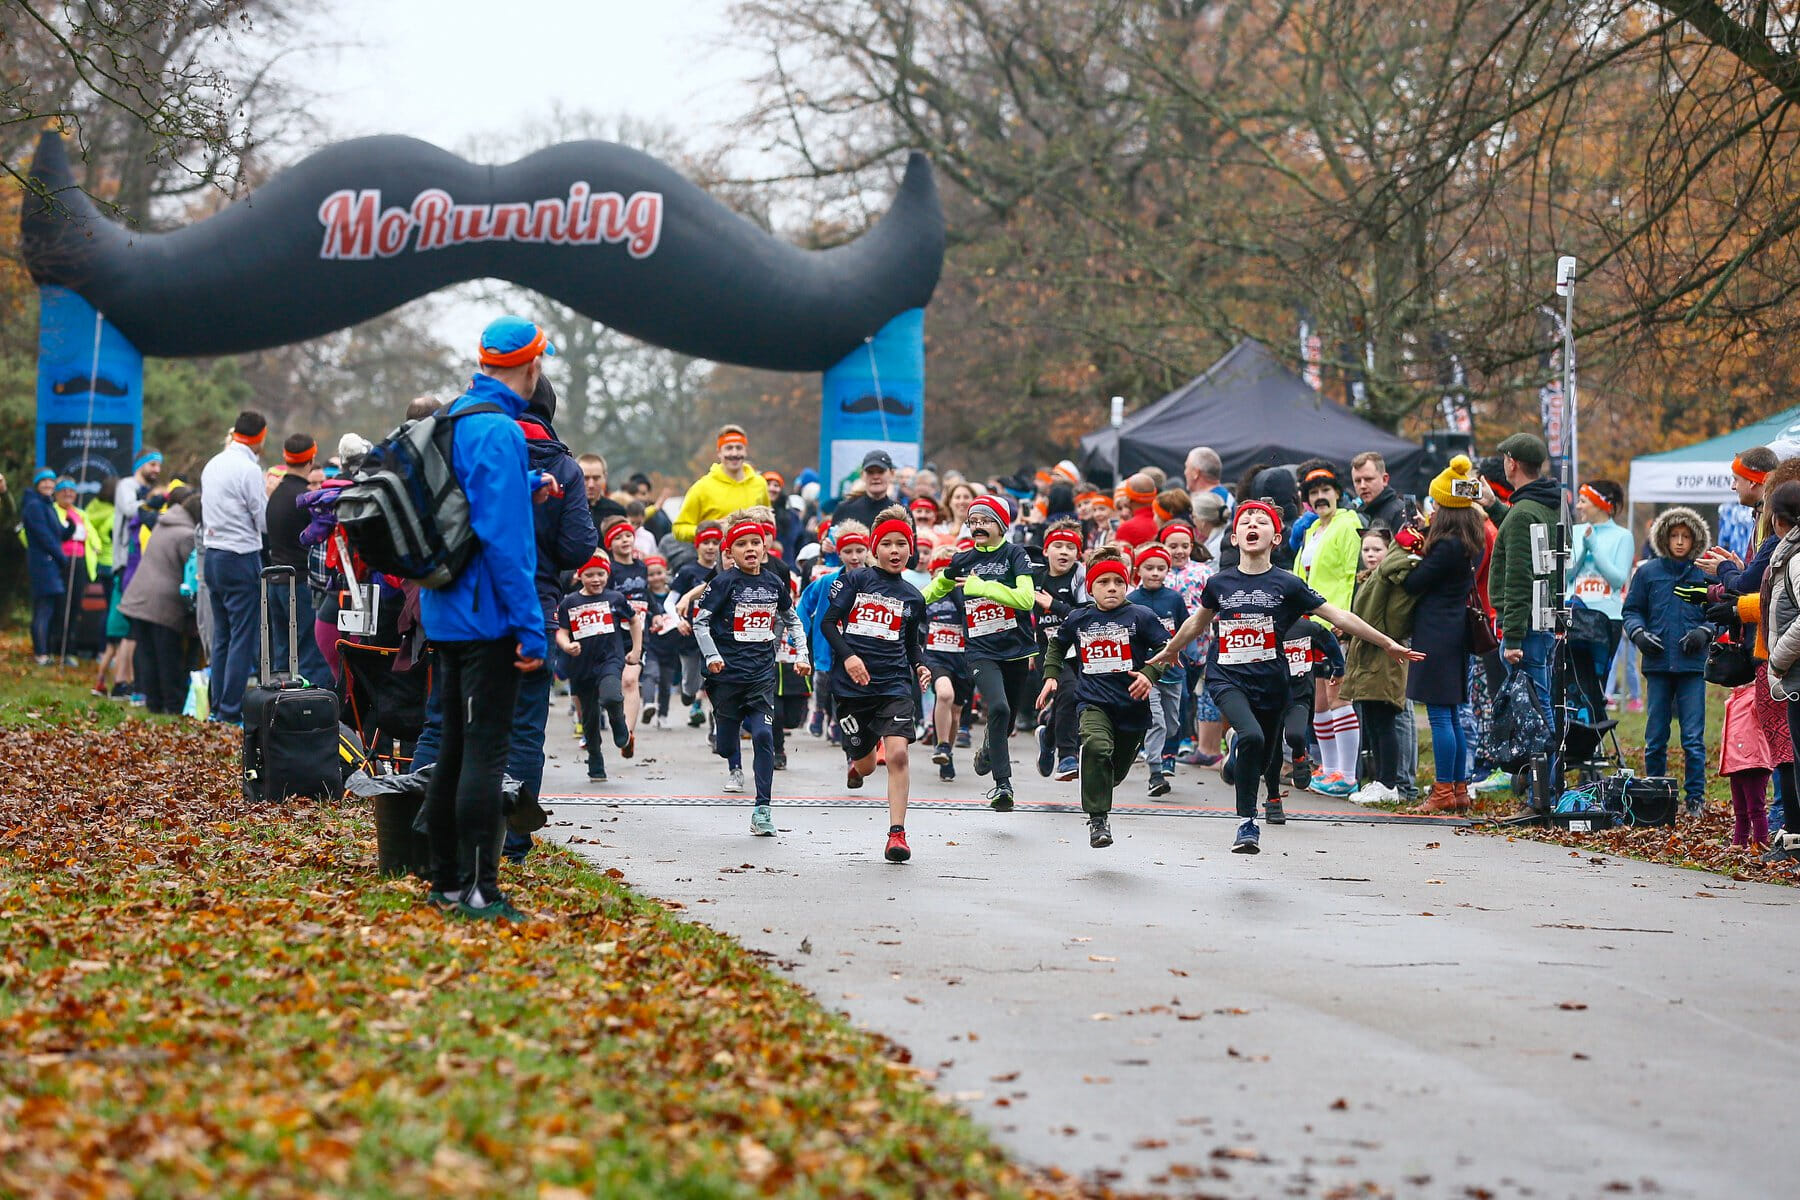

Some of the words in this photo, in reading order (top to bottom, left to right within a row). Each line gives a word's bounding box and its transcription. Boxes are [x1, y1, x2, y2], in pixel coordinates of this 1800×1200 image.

[318, 181, 663, 259] MoRunning
[1676, 475, 1703, 488] STOP
[576, 613, 605, 628] 2517
[855, 607, 893, 625] 2510
[972, 606, 1006, 623] 2533
[933, 633, 961, 645] 2555
[1225, 633, 1265, 648] 2504
[1086, 645, 1122, 659] 2511
[1285, 650, 1306, 663] 566
